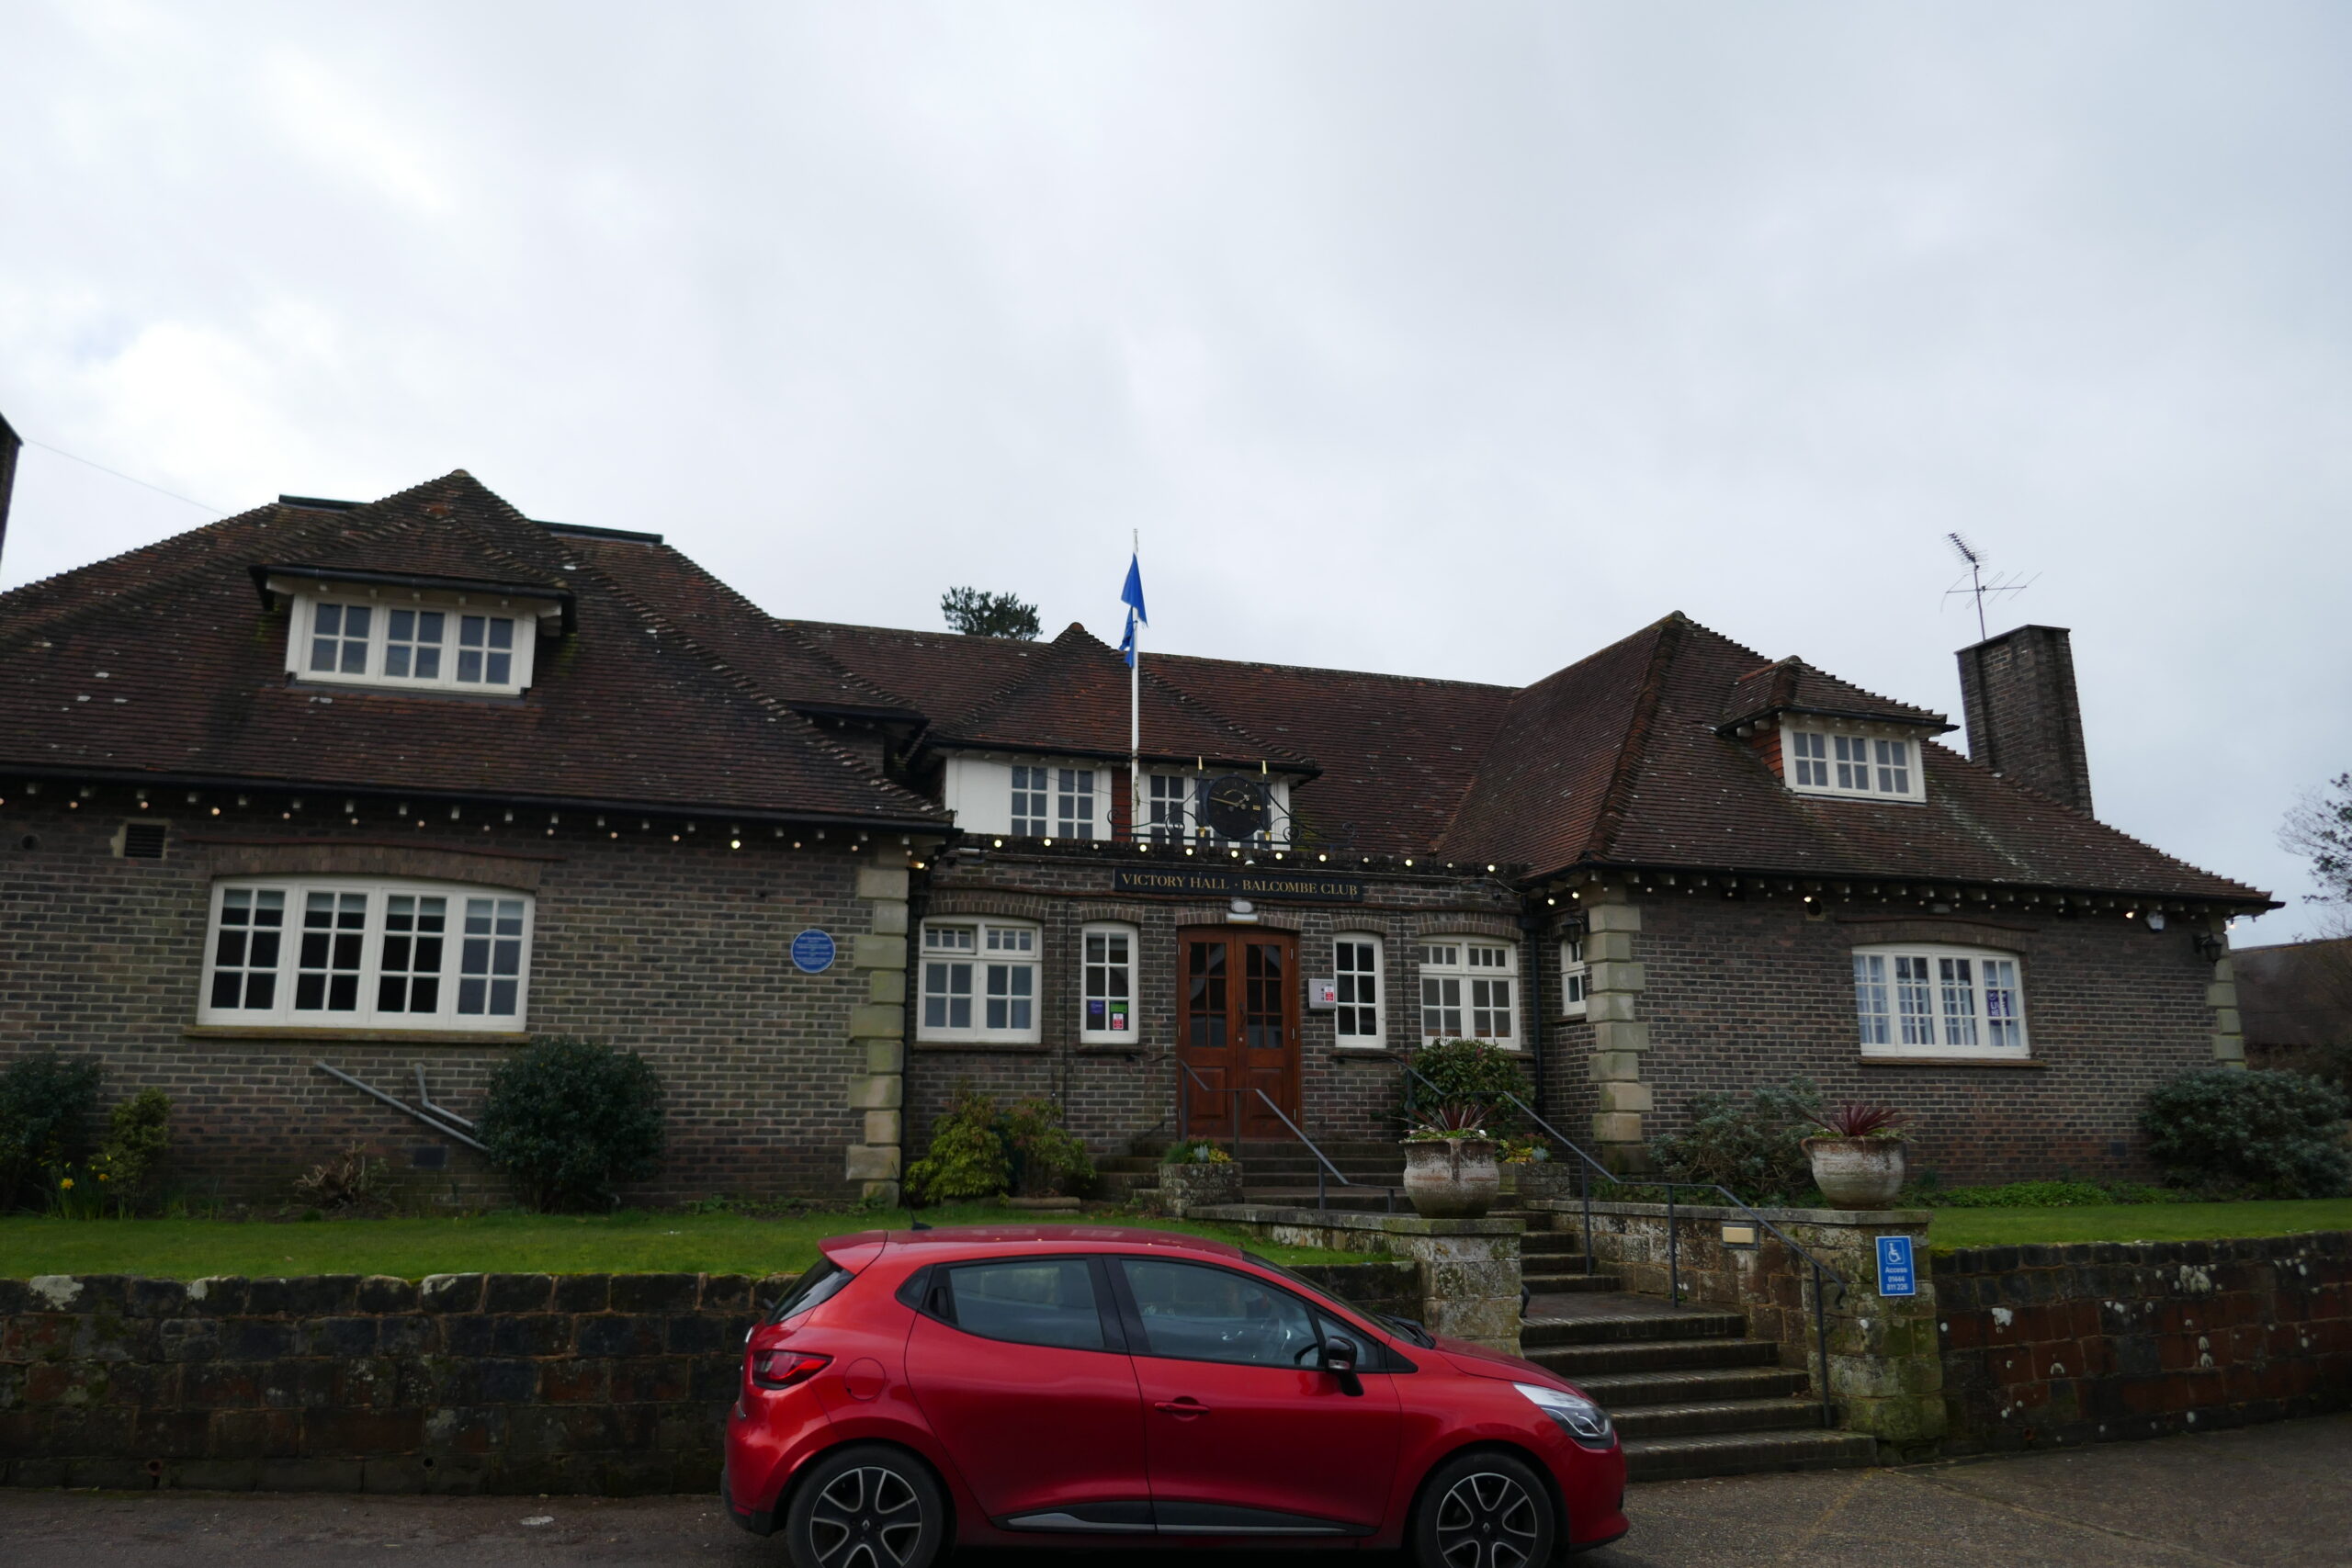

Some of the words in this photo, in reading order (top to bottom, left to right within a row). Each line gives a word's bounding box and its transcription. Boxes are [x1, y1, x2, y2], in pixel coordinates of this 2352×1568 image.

[1122, 874, 1185, 888] VICTORY
[1190, 876, 1230, 890] HALL
[1242, 879, 1317, 894] BALCOMBE
[1320, 883, 1358, 896] CLUB
